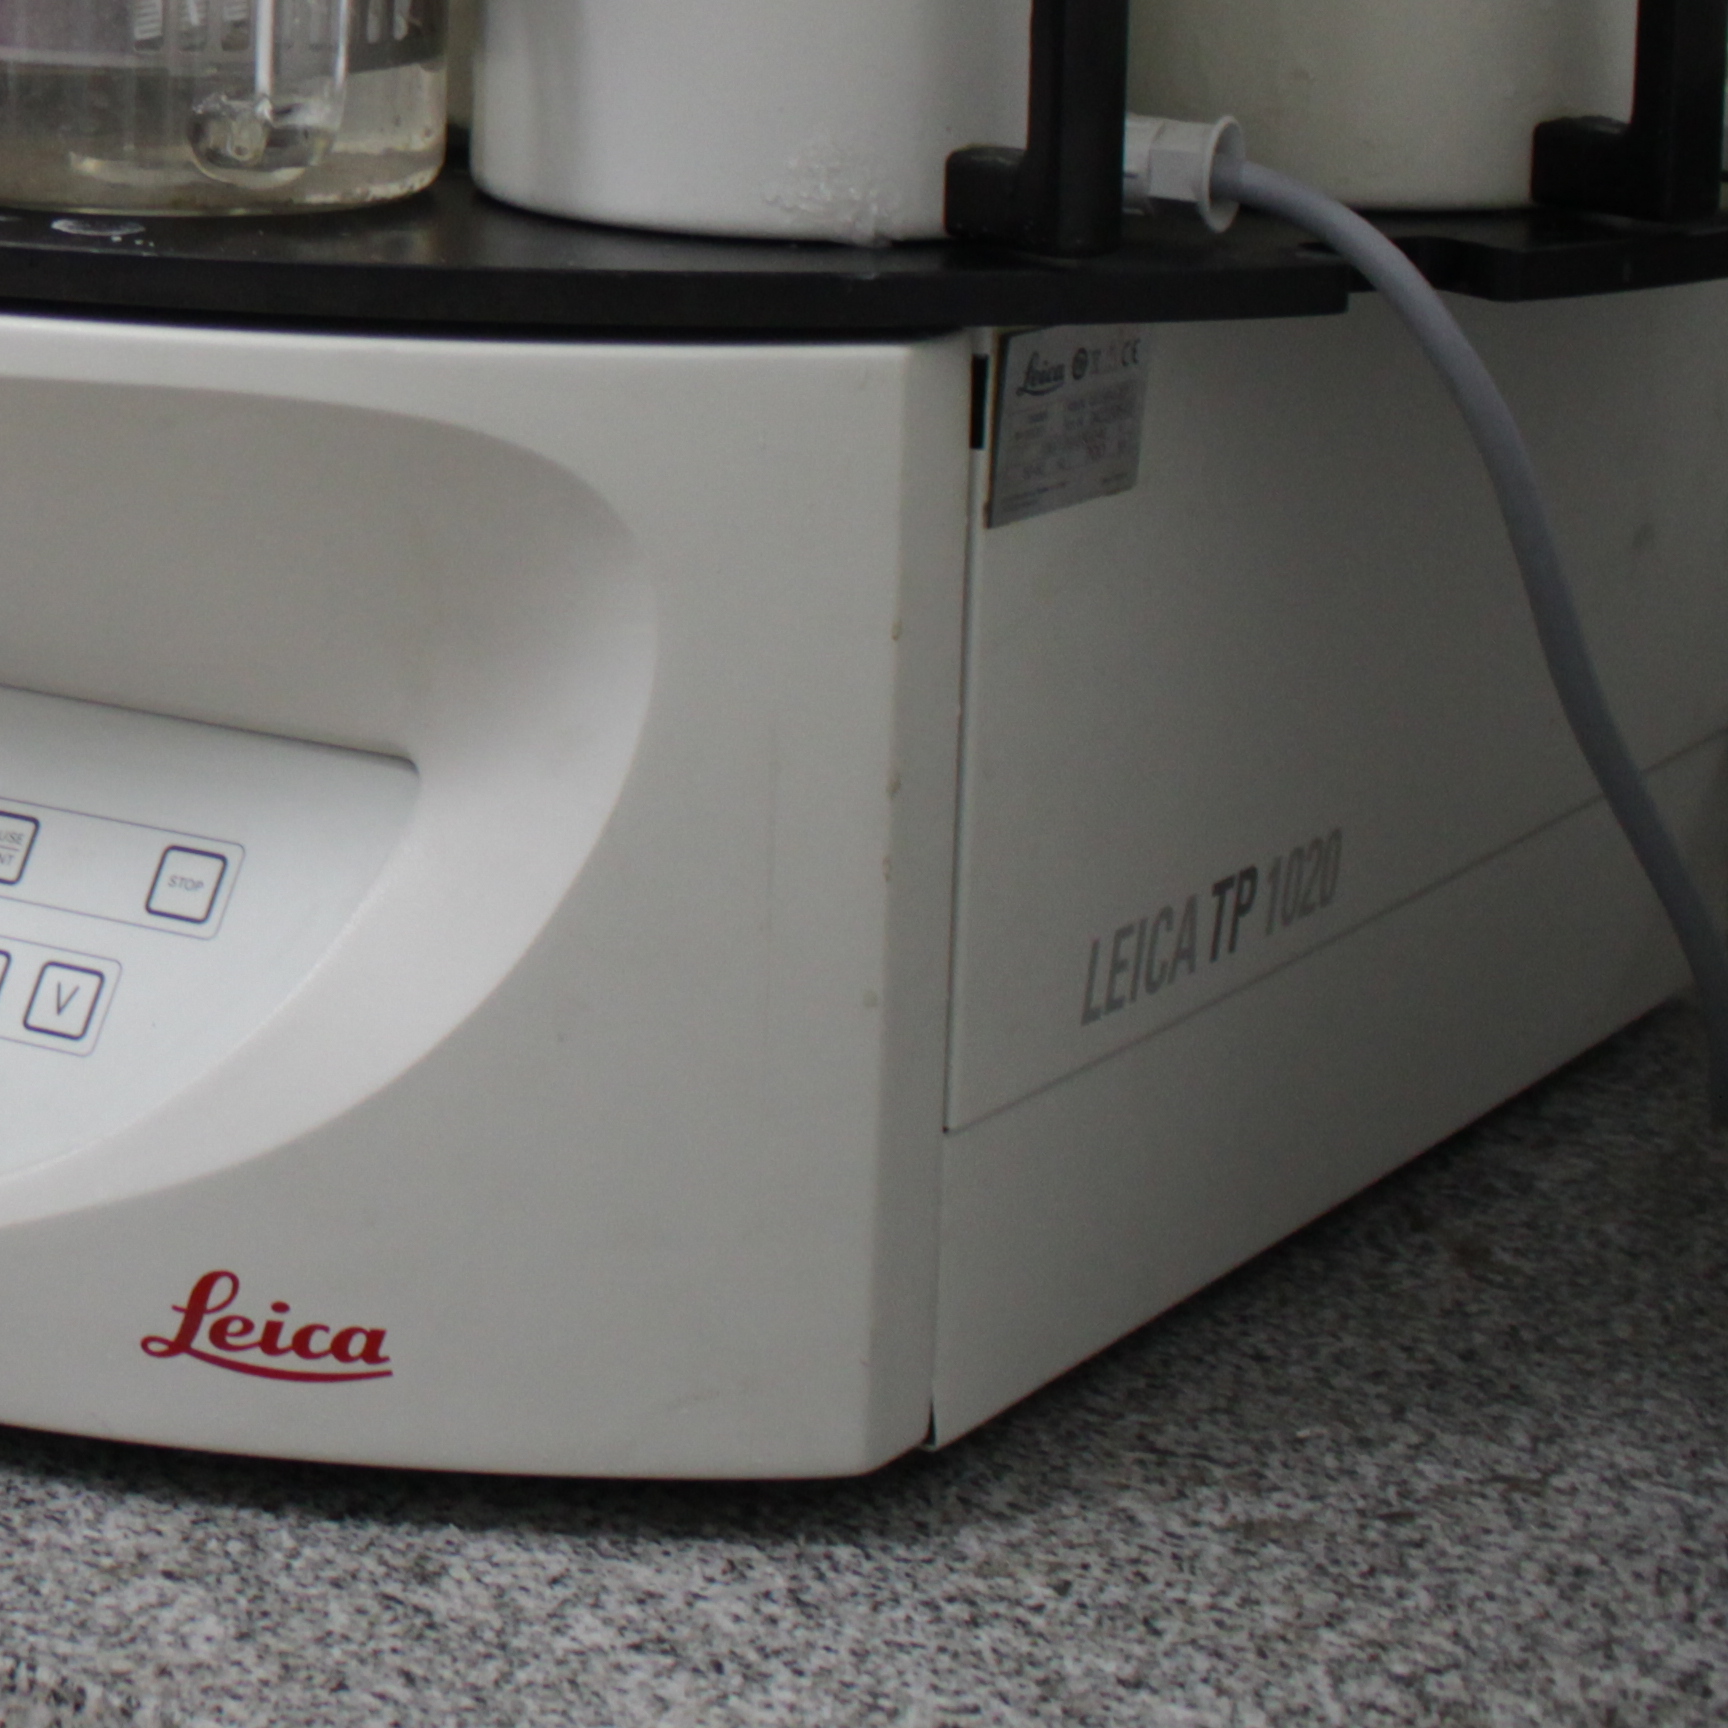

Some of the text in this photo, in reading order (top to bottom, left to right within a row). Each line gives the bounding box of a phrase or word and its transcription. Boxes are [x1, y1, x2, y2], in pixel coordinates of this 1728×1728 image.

[168, 874, 204, 894] STOP
[1081, 891, 1198, 1026] LEICA
[141, 1270, 393, 1382] Leica
